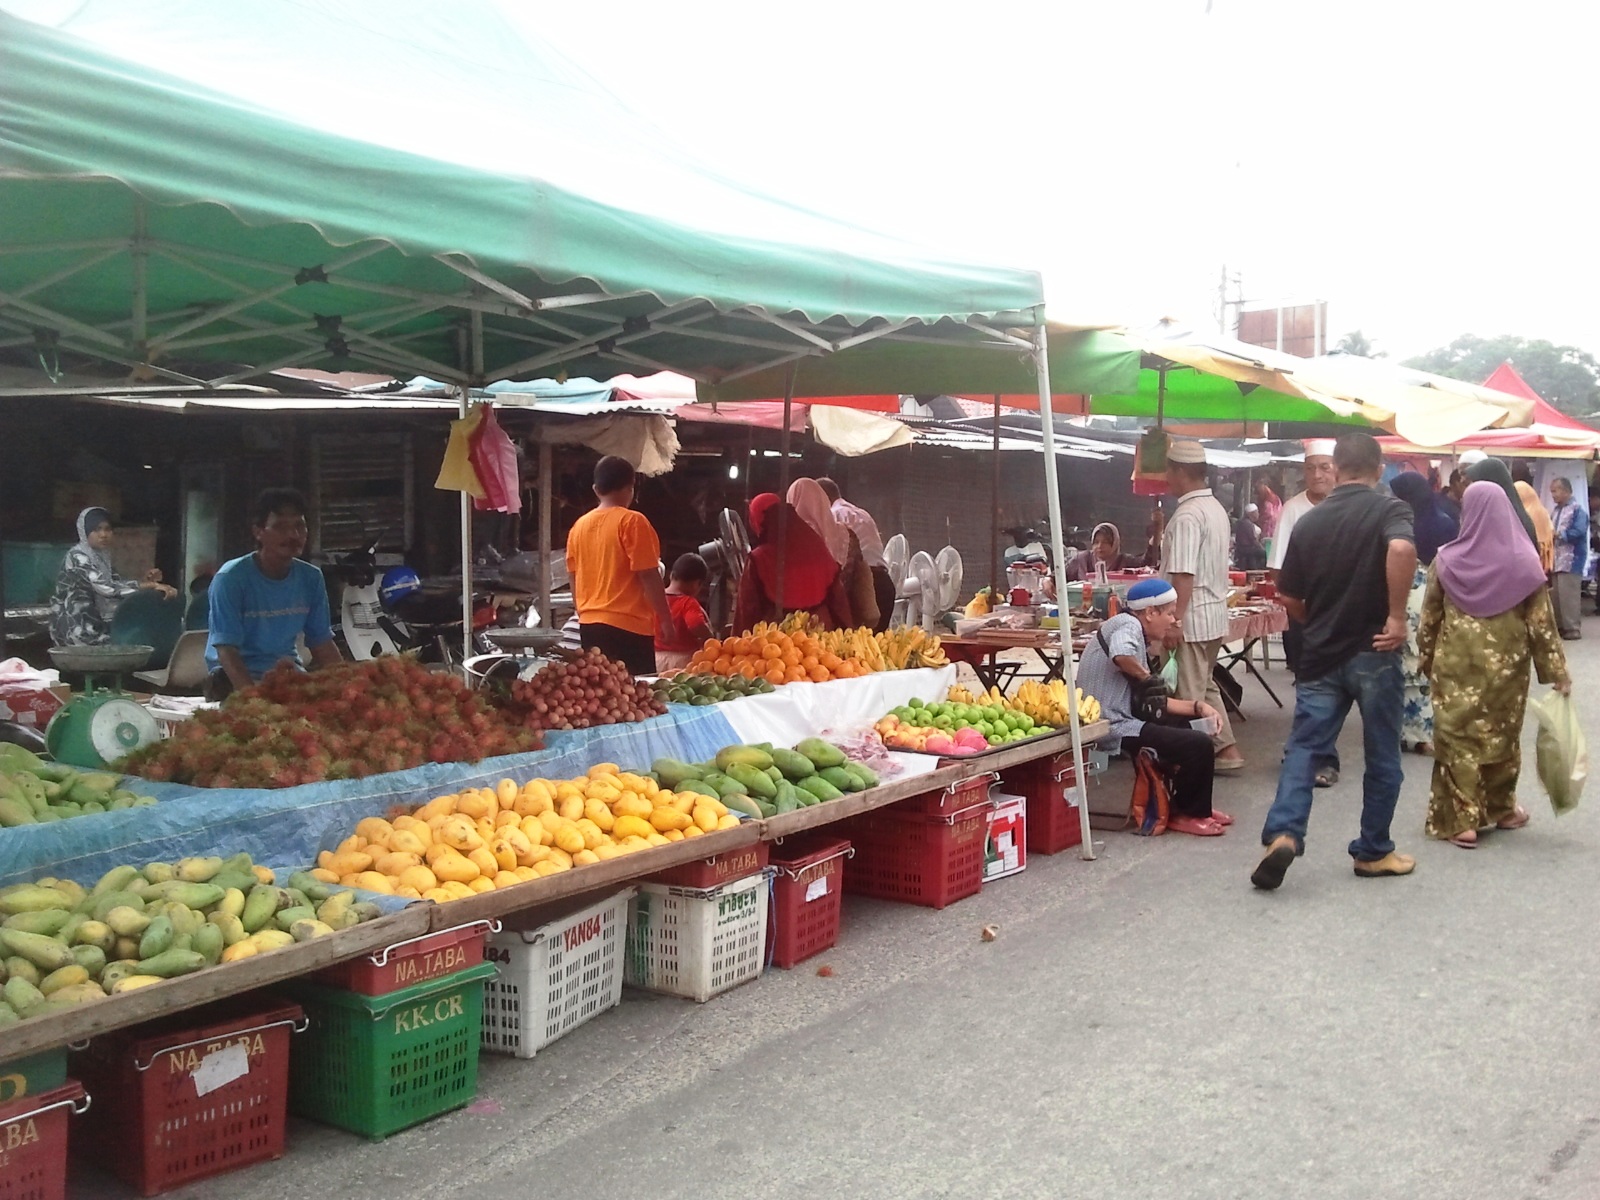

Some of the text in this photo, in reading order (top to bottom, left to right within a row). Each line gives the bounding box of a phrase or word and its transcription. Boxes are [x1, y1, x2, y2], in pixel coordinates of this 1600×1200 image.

[715, 852, 759, 879] NA.TABA
[563, 914, 601, 952] YAN84
[395, 946, 466, 983] NA.TABA
[394, 994, 464, 1035] KK.CR
[0, 1118, 39, 1153] BA
